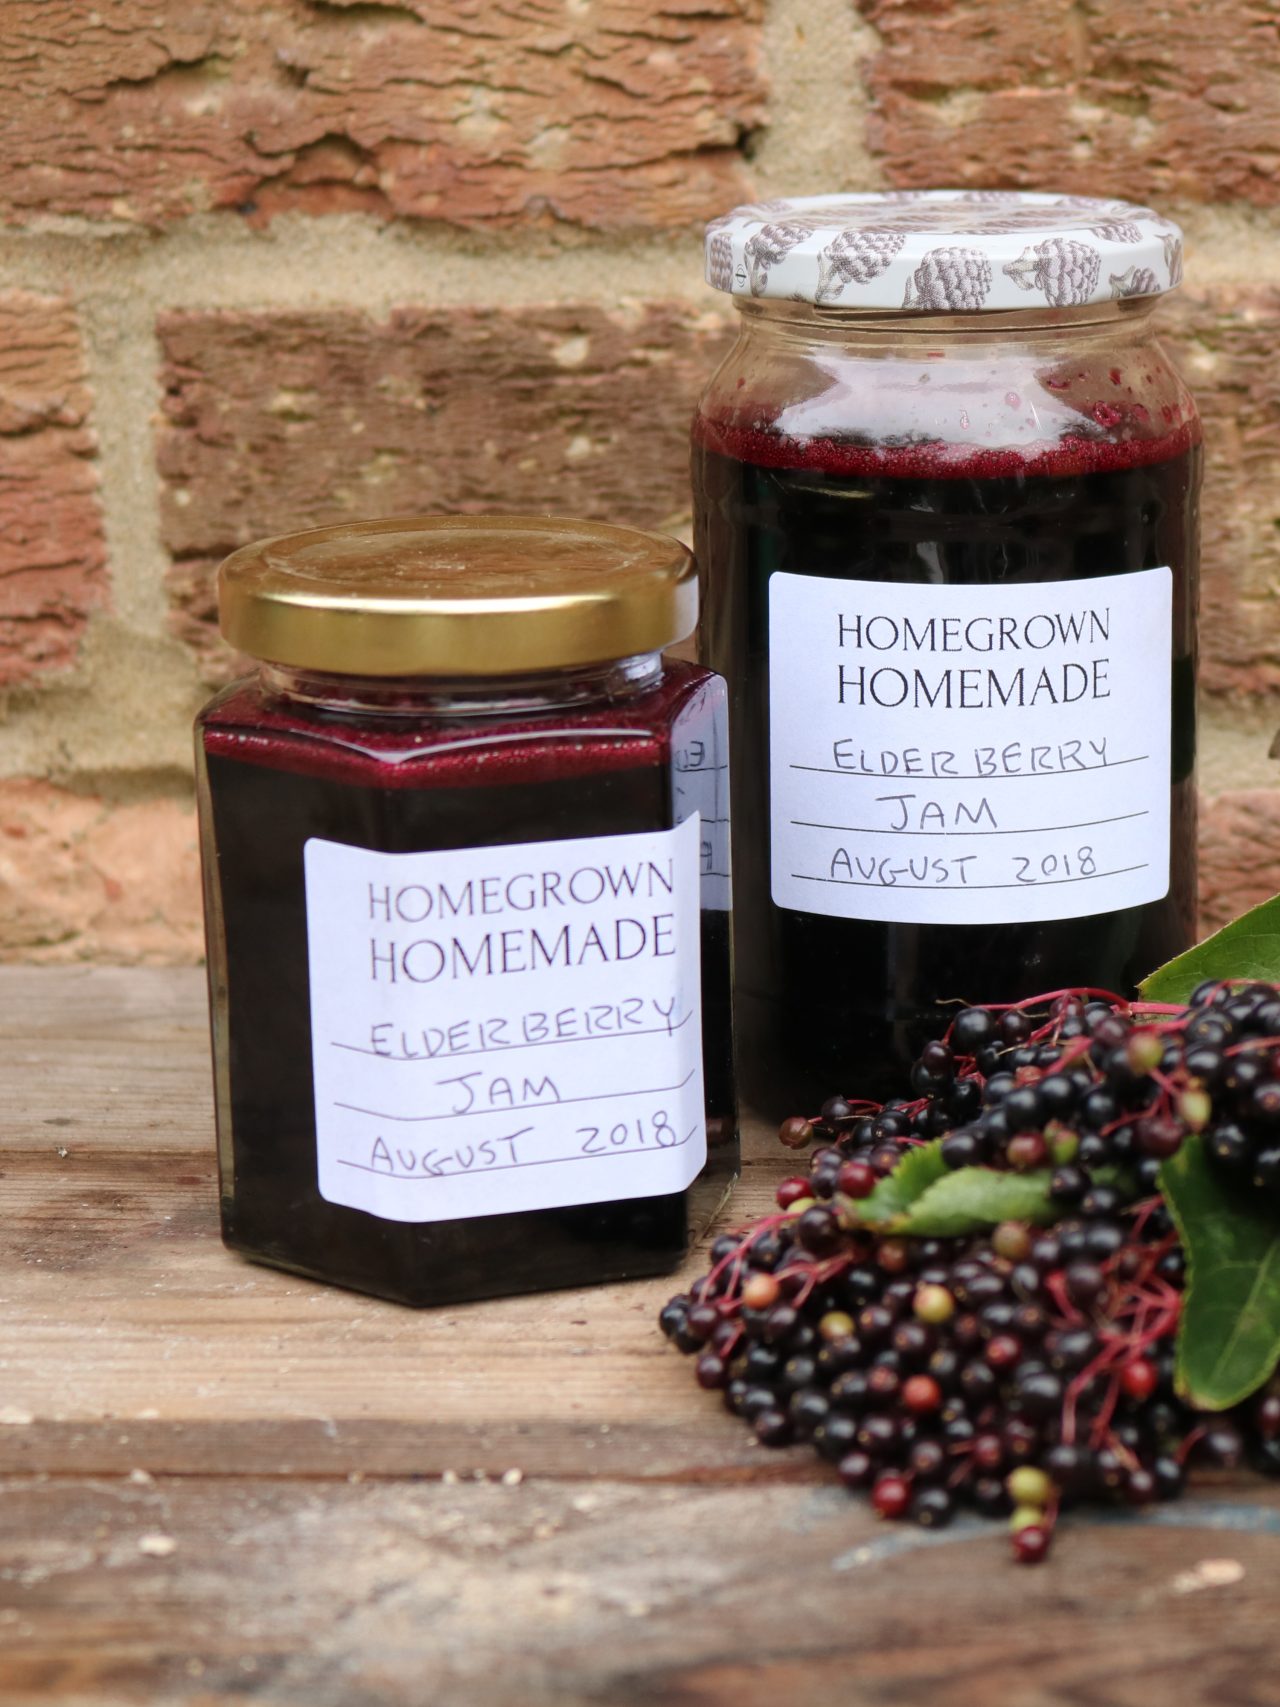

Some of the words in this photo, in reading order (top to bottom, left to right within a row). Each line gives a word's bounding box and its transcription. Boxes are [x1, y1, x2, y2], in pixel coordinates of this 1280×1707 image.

[838, 608, 1110, 652] HOMEGROWN
[838, 659, 1111, 709] HOMEMADE
[875, 794, 998, 831] JAM
[830, 847, 978, 886] AUGUST
[1012, 846, 1097, 884] 2018
[368, 858, 674, 923] HOMEGROWN
[370, 913, 677, 984] HOMEMADE
[435, 1071, 561, 1115] JAM
[371, 1126, 535, 1177] AUGUST
[576, 1110, 678, 1154] 2018
